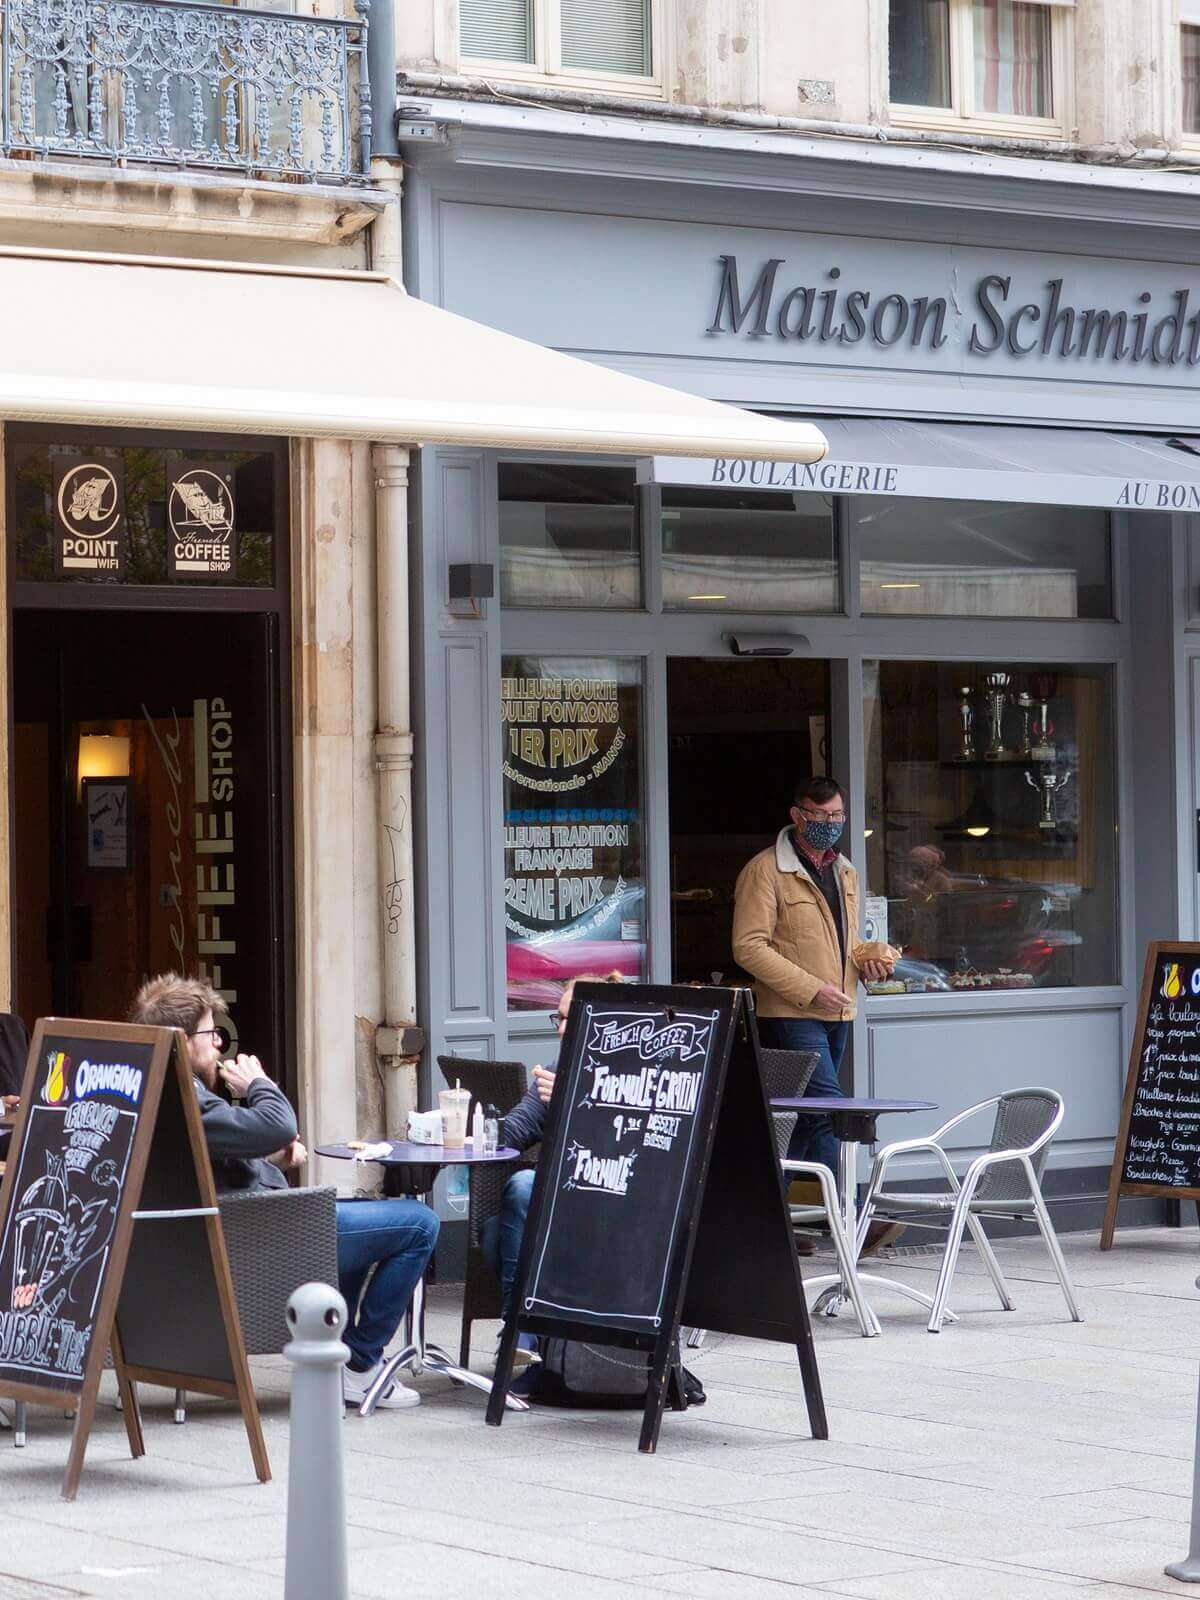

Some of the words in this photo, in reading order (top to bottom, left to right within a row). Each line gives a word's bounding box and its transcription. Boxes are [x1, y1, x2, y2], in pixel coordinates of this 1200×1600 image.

[705, 254, 949, 350] Maison
[711, 457, 899, 492] BOULANGERIE
[1116, 483, 1149, 506] AU
[63, 538, 119, 558] POINT
[174, 543, 230, 561] COFFEE
[97, 559, 119, 569] WIFI
[209, 561, 232, 572] SHOP
[501, 677, 562, 700] EILLEURE
[564, 679, 617, 701] TOURTE
[541, 701, 620, 724] POIVRONS
[211, 697, 235, 802] SHOP
[509, 728, 546, 768] 1ER
[550, 728, 599, 769] PRIX
[592, 726, 626, 778] NANCY
[552, 825, 629, 848] TRADITION
[558, 876, 605, 920] PRIX
[75, 1060, 142, 1102] ORANGINA
